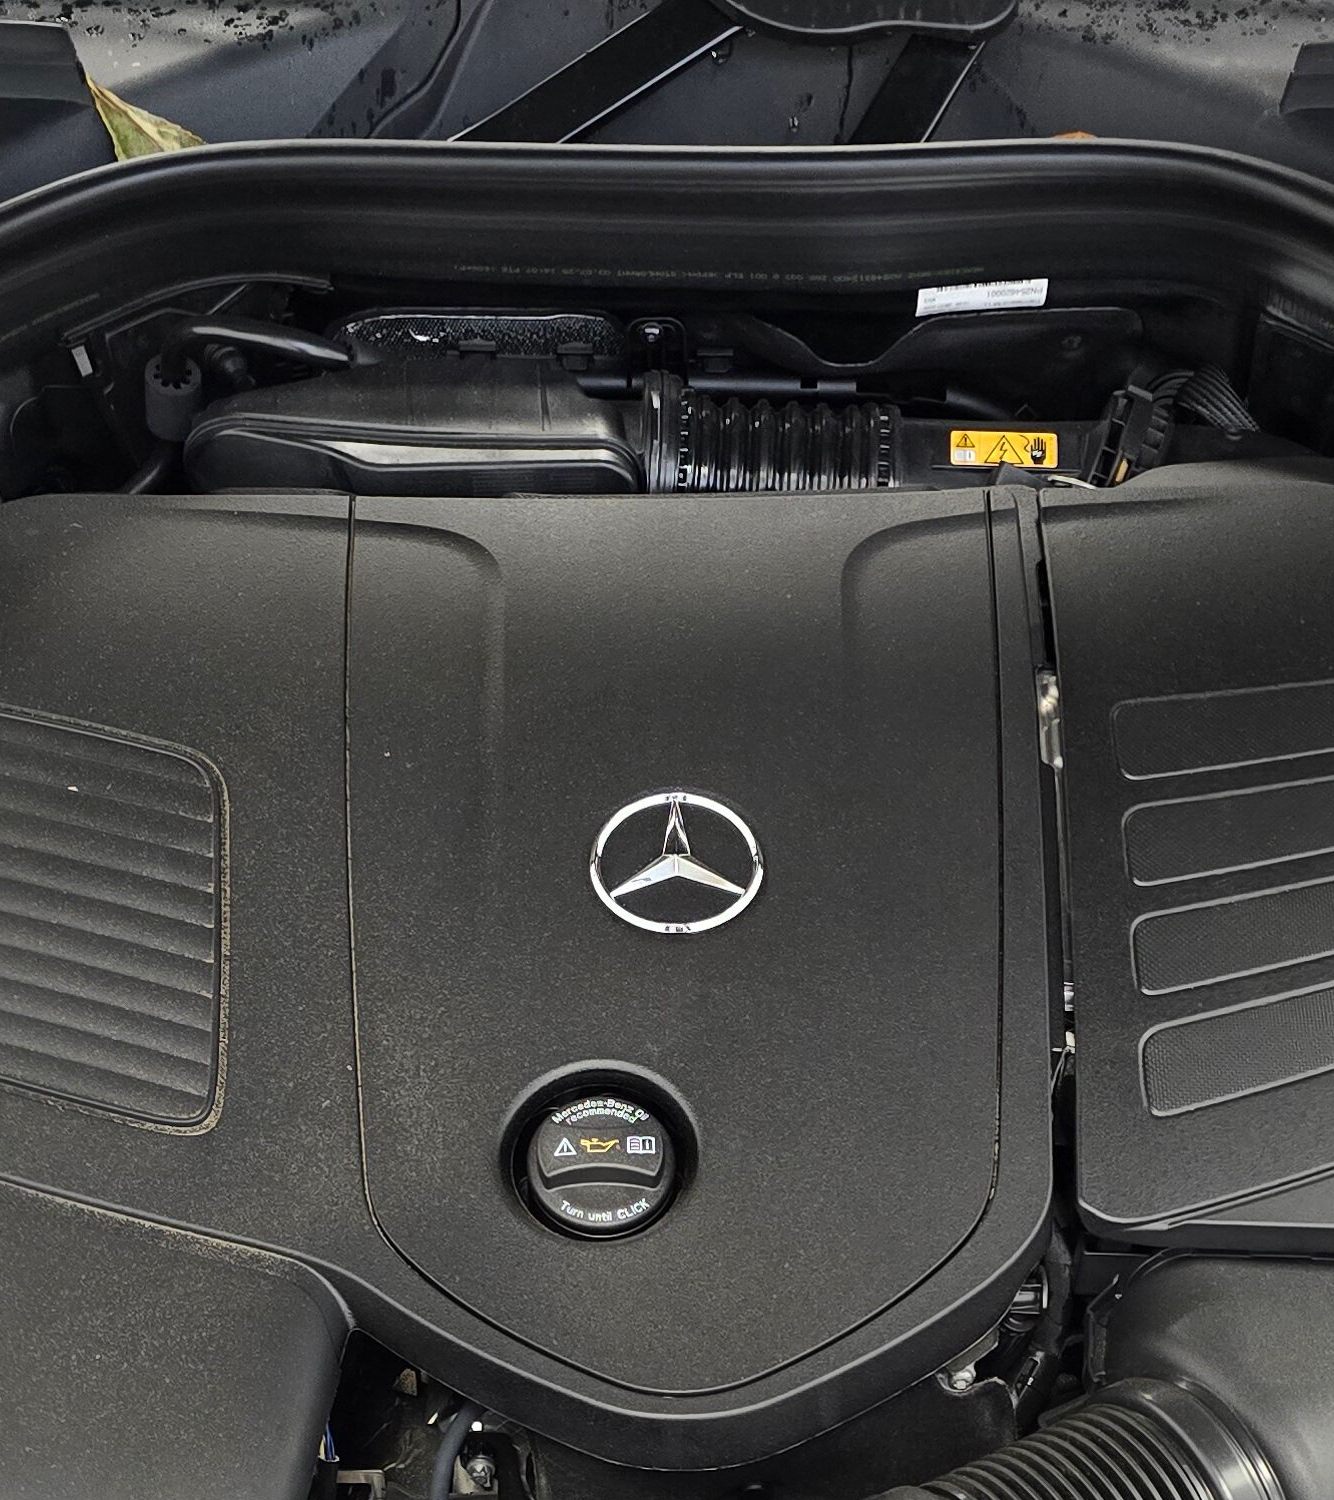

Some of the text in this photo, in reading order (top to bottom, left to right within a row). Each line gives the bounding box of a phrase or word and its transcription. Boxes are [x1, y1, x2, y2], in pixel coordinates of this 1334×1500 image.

[551, 1098, 635, 1124] Mercedes-Benz
[565, 1106, 639, 1126] recommended
[559, 1197, 651, 1222] Turn until CLICK
